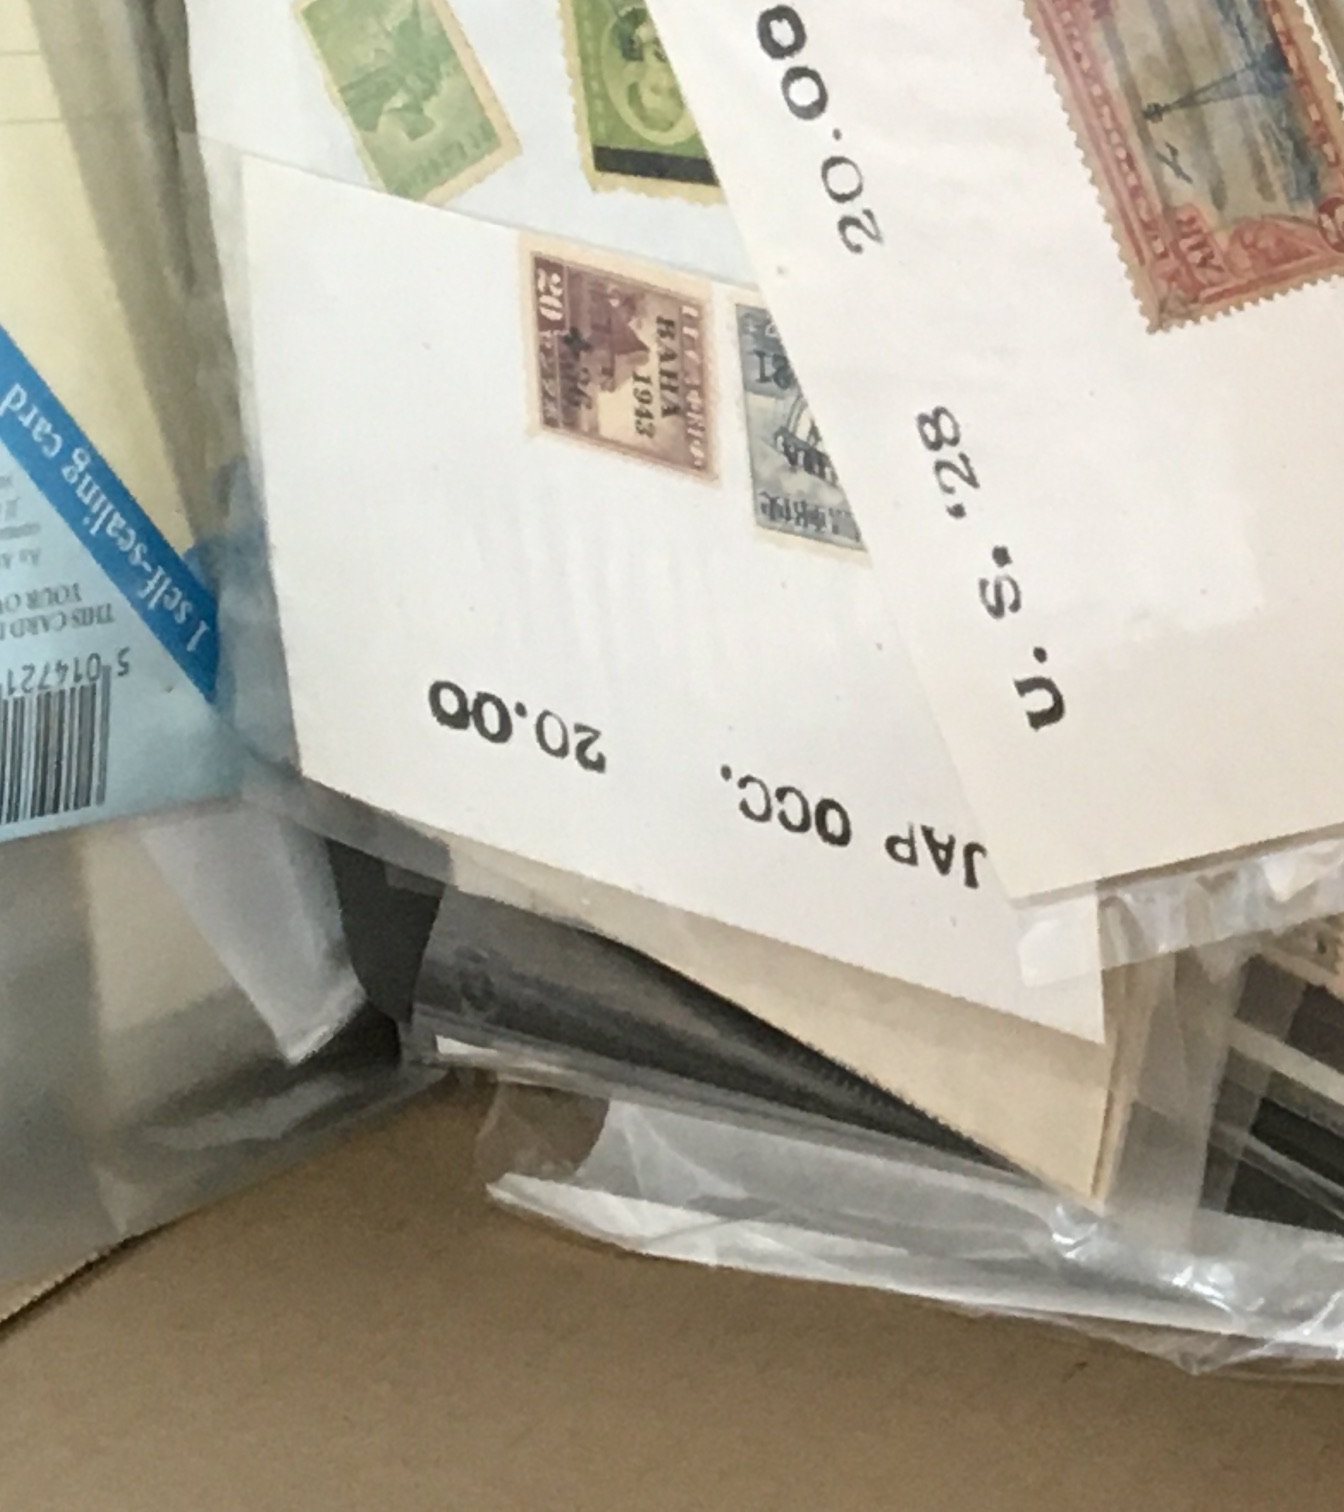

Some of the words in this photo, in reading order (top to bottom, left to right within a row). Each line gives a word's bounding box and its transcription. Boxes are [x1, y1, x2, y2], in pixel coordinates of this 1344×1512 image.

[757, 4, 884, 255] 20.00
[534, 267, 563, 328] 20
[1, 383, 63, 459] card
[631, 368, 655, 439] 1943
[60, 445, 192, 624] self-sealing
[26, 582, 82, 609] YOUR
[70, 603, 115, 625] THIS
[980, 544, 1023, 618] S.
[10, 611, 68, 639] CARD
[1014, 645, 1066, 729] U.
[430, 681, 607, 772] 20.00
[721, 763, 852, 847] OCC.
[886, 826, 986, 888] JAP
